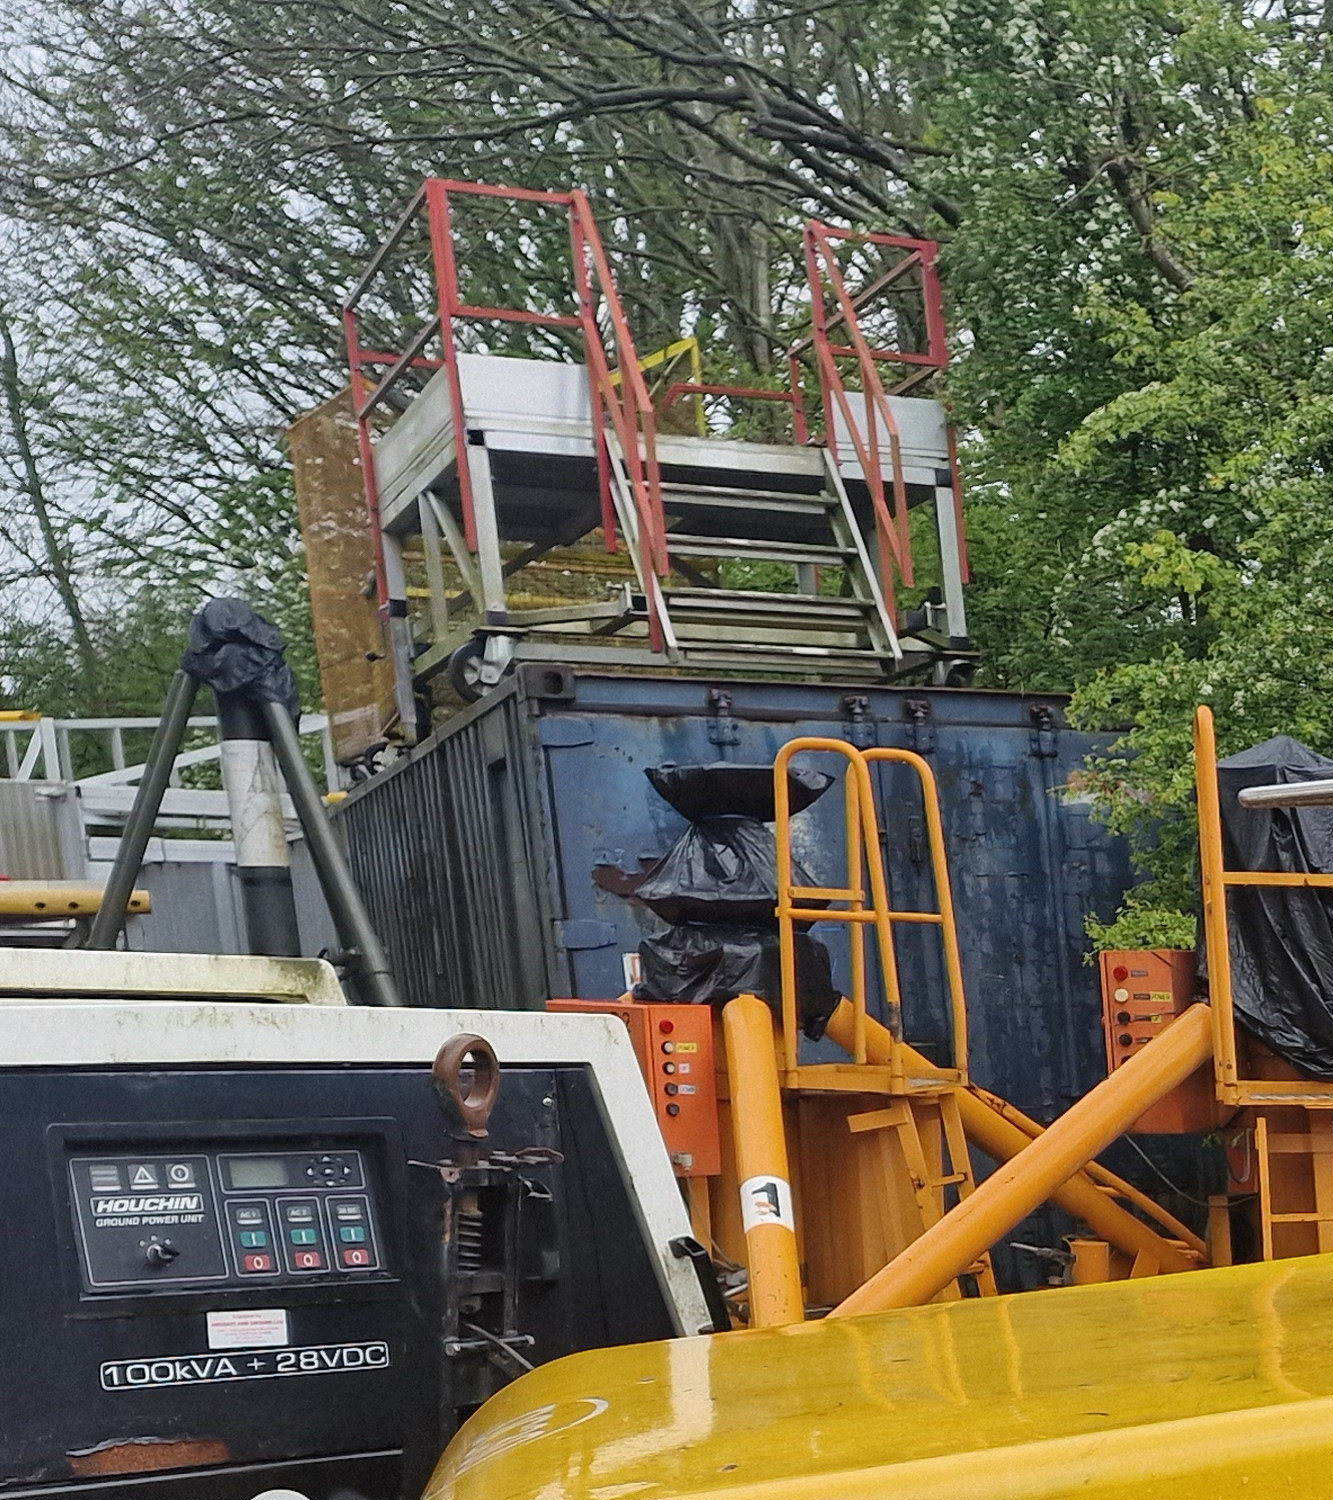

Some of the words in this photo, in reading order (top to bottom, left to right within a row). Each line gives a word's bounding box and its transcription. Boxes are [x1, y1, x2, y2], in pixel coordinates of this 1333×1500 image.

[97, 1197, 199, 1213] HOUCHIN
[96, 1217, 140, 1227] GROUND
[141, 1216, 179, 1225] POWER
[180, 1214, 204, 1223] UNIT
[104, 1358, 238, 1386] 100kVA
[247, 1357, 265, 1371] +
[276, 1346, 386, 1373] 28VDC
